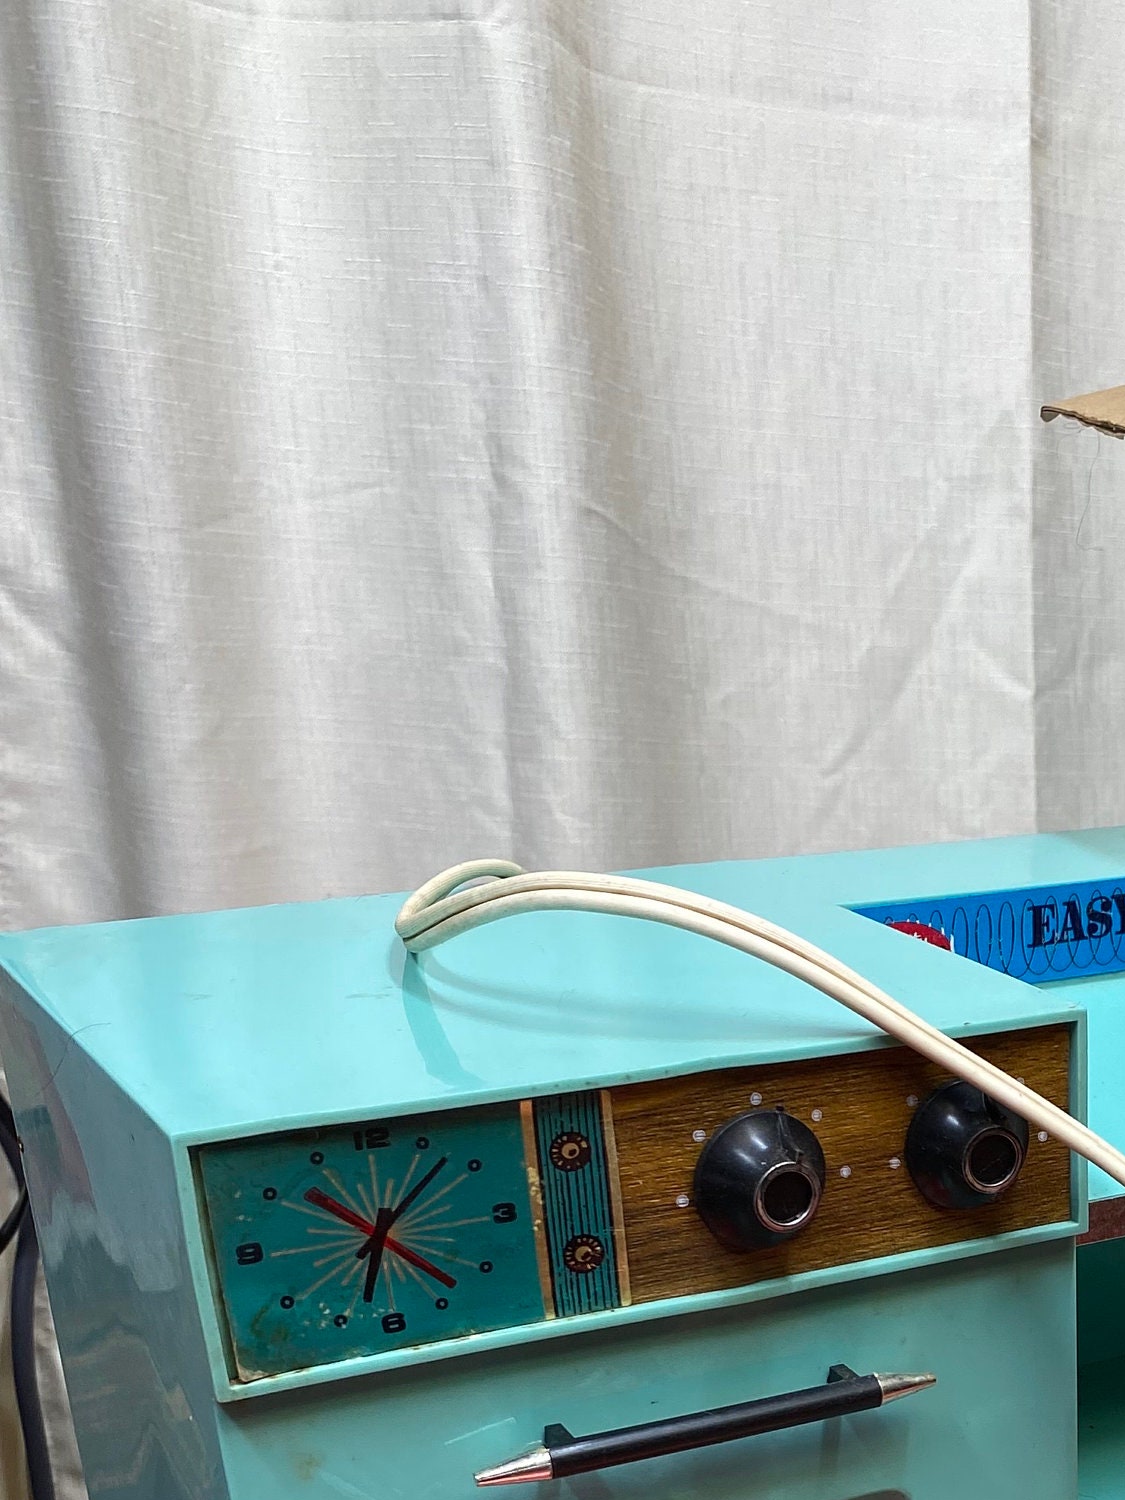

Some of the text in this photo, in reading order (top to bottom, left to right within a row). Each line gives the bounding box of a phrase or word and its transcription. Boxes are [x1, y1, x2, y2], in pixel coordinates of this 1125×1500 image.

[352, 1127, 391, 1151] 12
[491, 1202, 517, 1224] 3
[235, 1241, 263, 1265] 9
